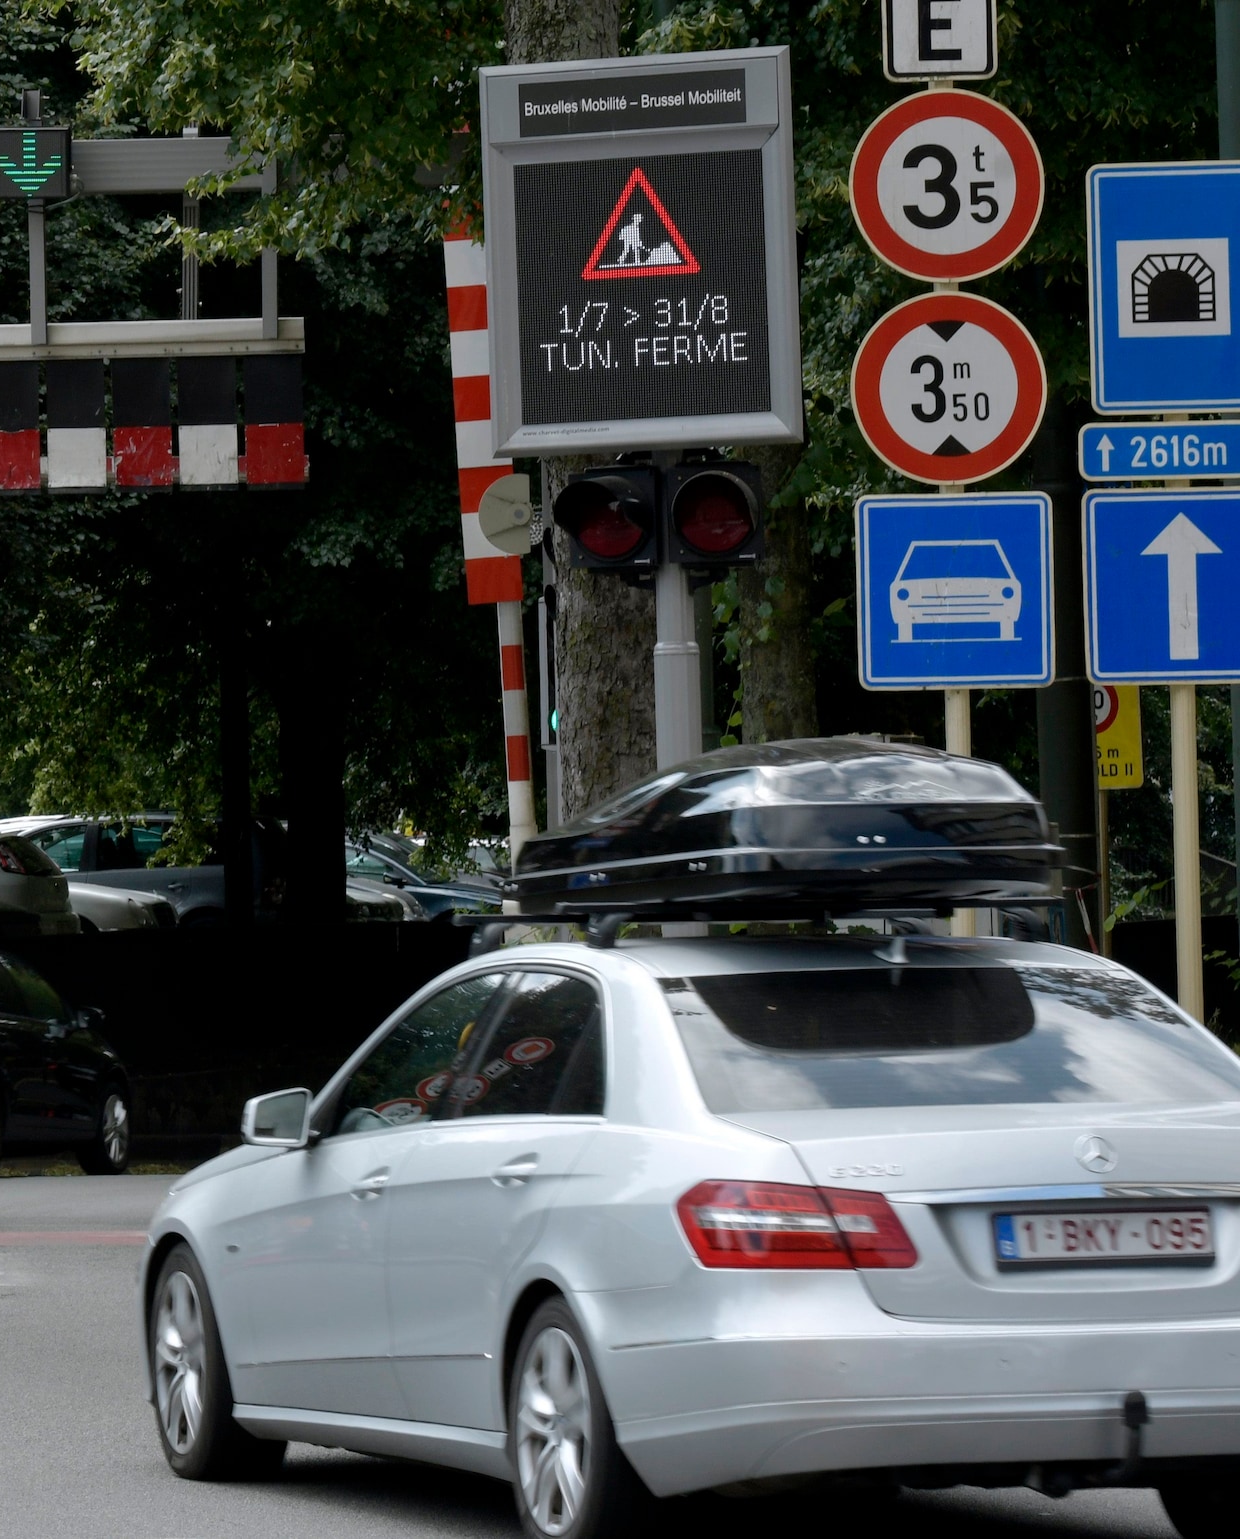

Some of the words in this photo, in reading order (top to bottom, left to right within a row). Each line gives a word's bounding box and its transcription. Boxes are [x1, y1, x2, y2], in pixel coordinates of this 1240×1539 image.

[918, 0, 963, 62] E
[524, 99, 578, 117] Bruxelles
[581, 95, 627, 113] Mobilité
[641, 91, 685, 109] Brussel
[688, 88, 742, 106] Mobiliteit
[902, 144, 961, 230] 3
[970, 181, 999, 224] 5
[559, 300, 609, 338] 1/7
[654, 293, 729, 331] 31/8
[539, 340, 619, 372] TUN.
[634, 331, 748, 367] FERME
[909, 354, 947, 424] 3
[952, 391, 990, 423] 50
[1130, 435, 1228, 469] 2616m
[1094, 690, 1104, 709] 0
[1097, 764, 1118, 778] LD
[1124, 763, 1134, 777] II
[1107, 748, 1119, 759] m
